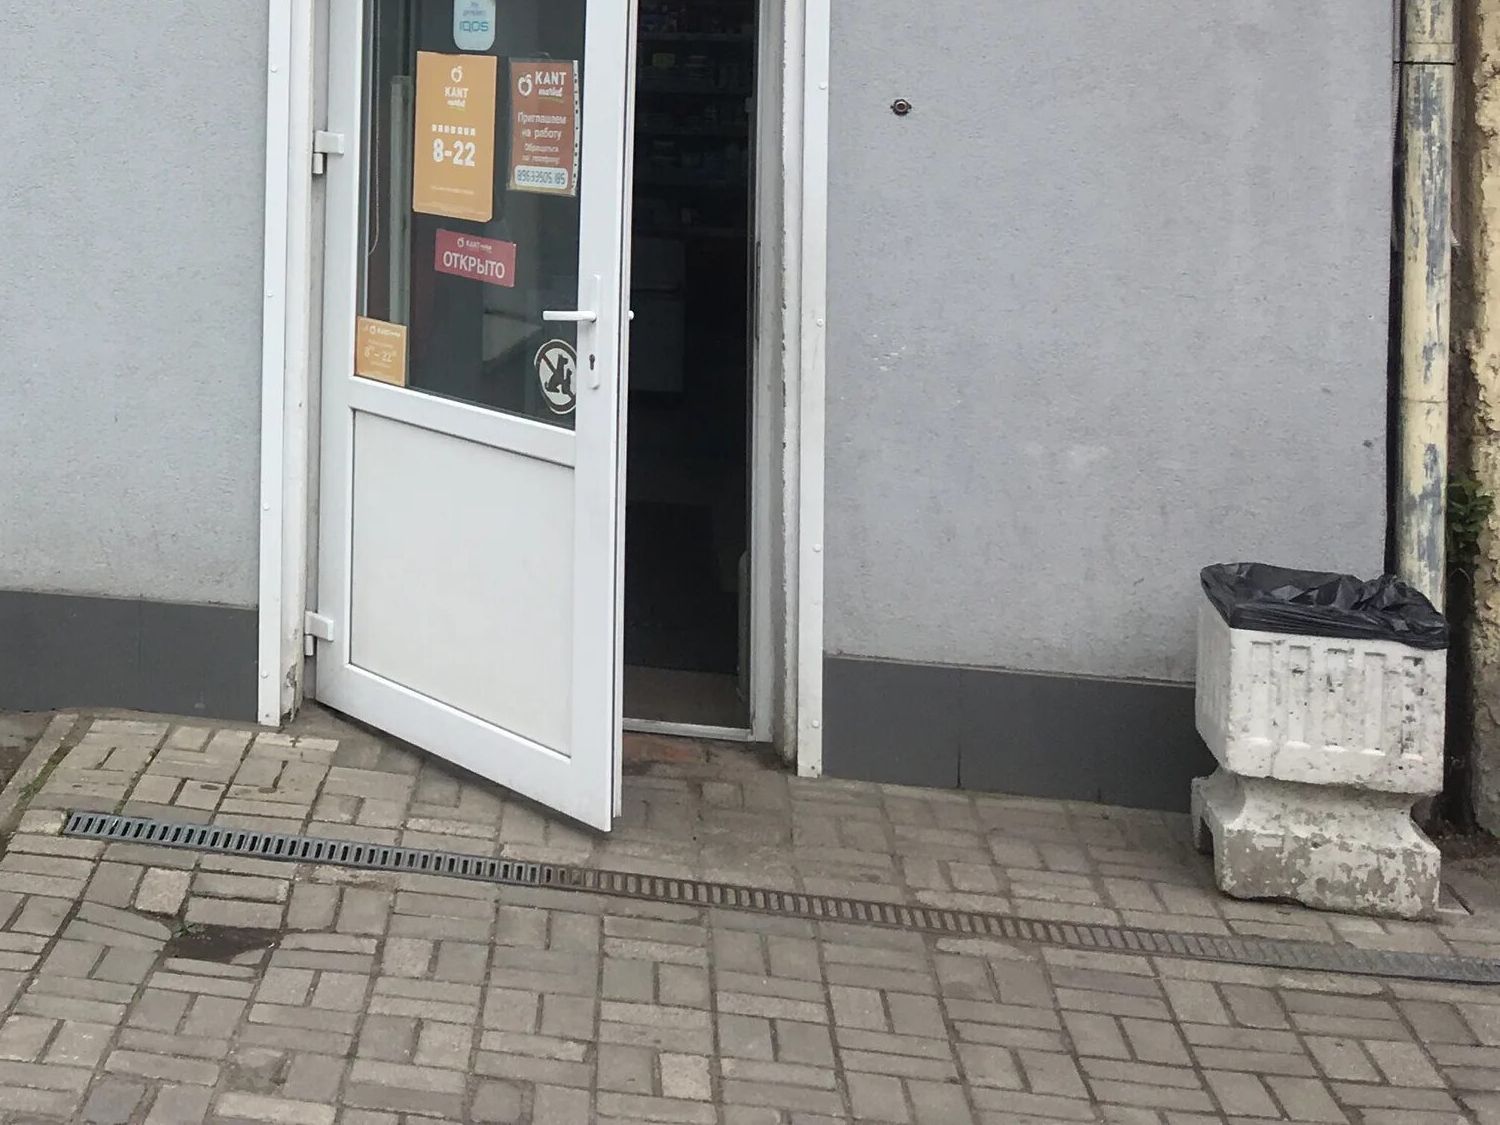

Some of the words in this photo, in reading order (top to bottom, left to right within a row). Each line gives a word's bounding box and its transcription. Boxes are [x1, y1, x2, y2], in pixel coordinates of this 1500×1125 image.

[534, 71, 567, 86] KANT
[534, 127, 562, 141] работу
[432, 138, 476, 167] 8-22
[443, 251, 505, 279] ОТКРЫТО
